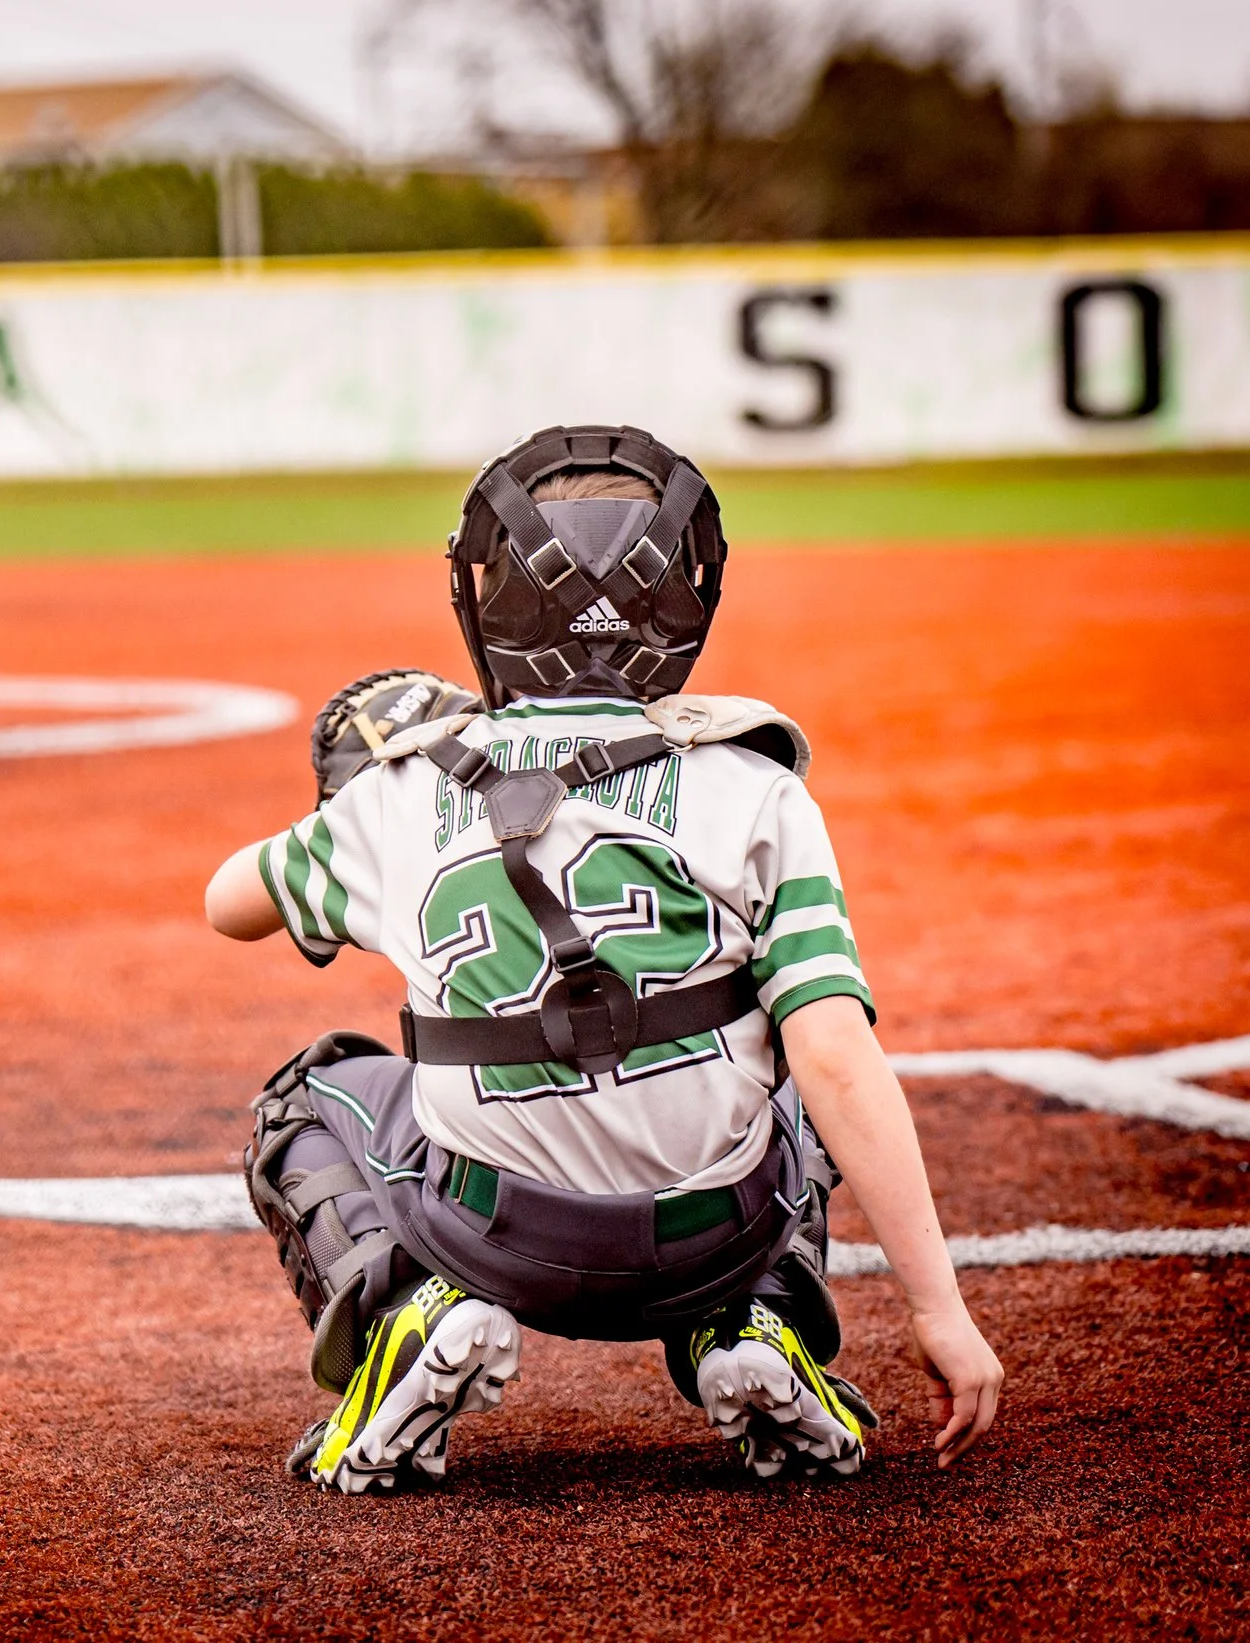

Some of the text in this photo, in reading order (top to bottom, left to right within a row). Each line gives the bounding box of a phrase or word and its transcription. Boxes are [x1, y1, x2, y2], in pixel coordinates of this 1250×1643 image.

[569, 619, 630, 633] adidas
[418, 832, 734, 1105] 22
[411, 1274, 450, 1315] 88
[750, 1304, 784, 1342] 88
